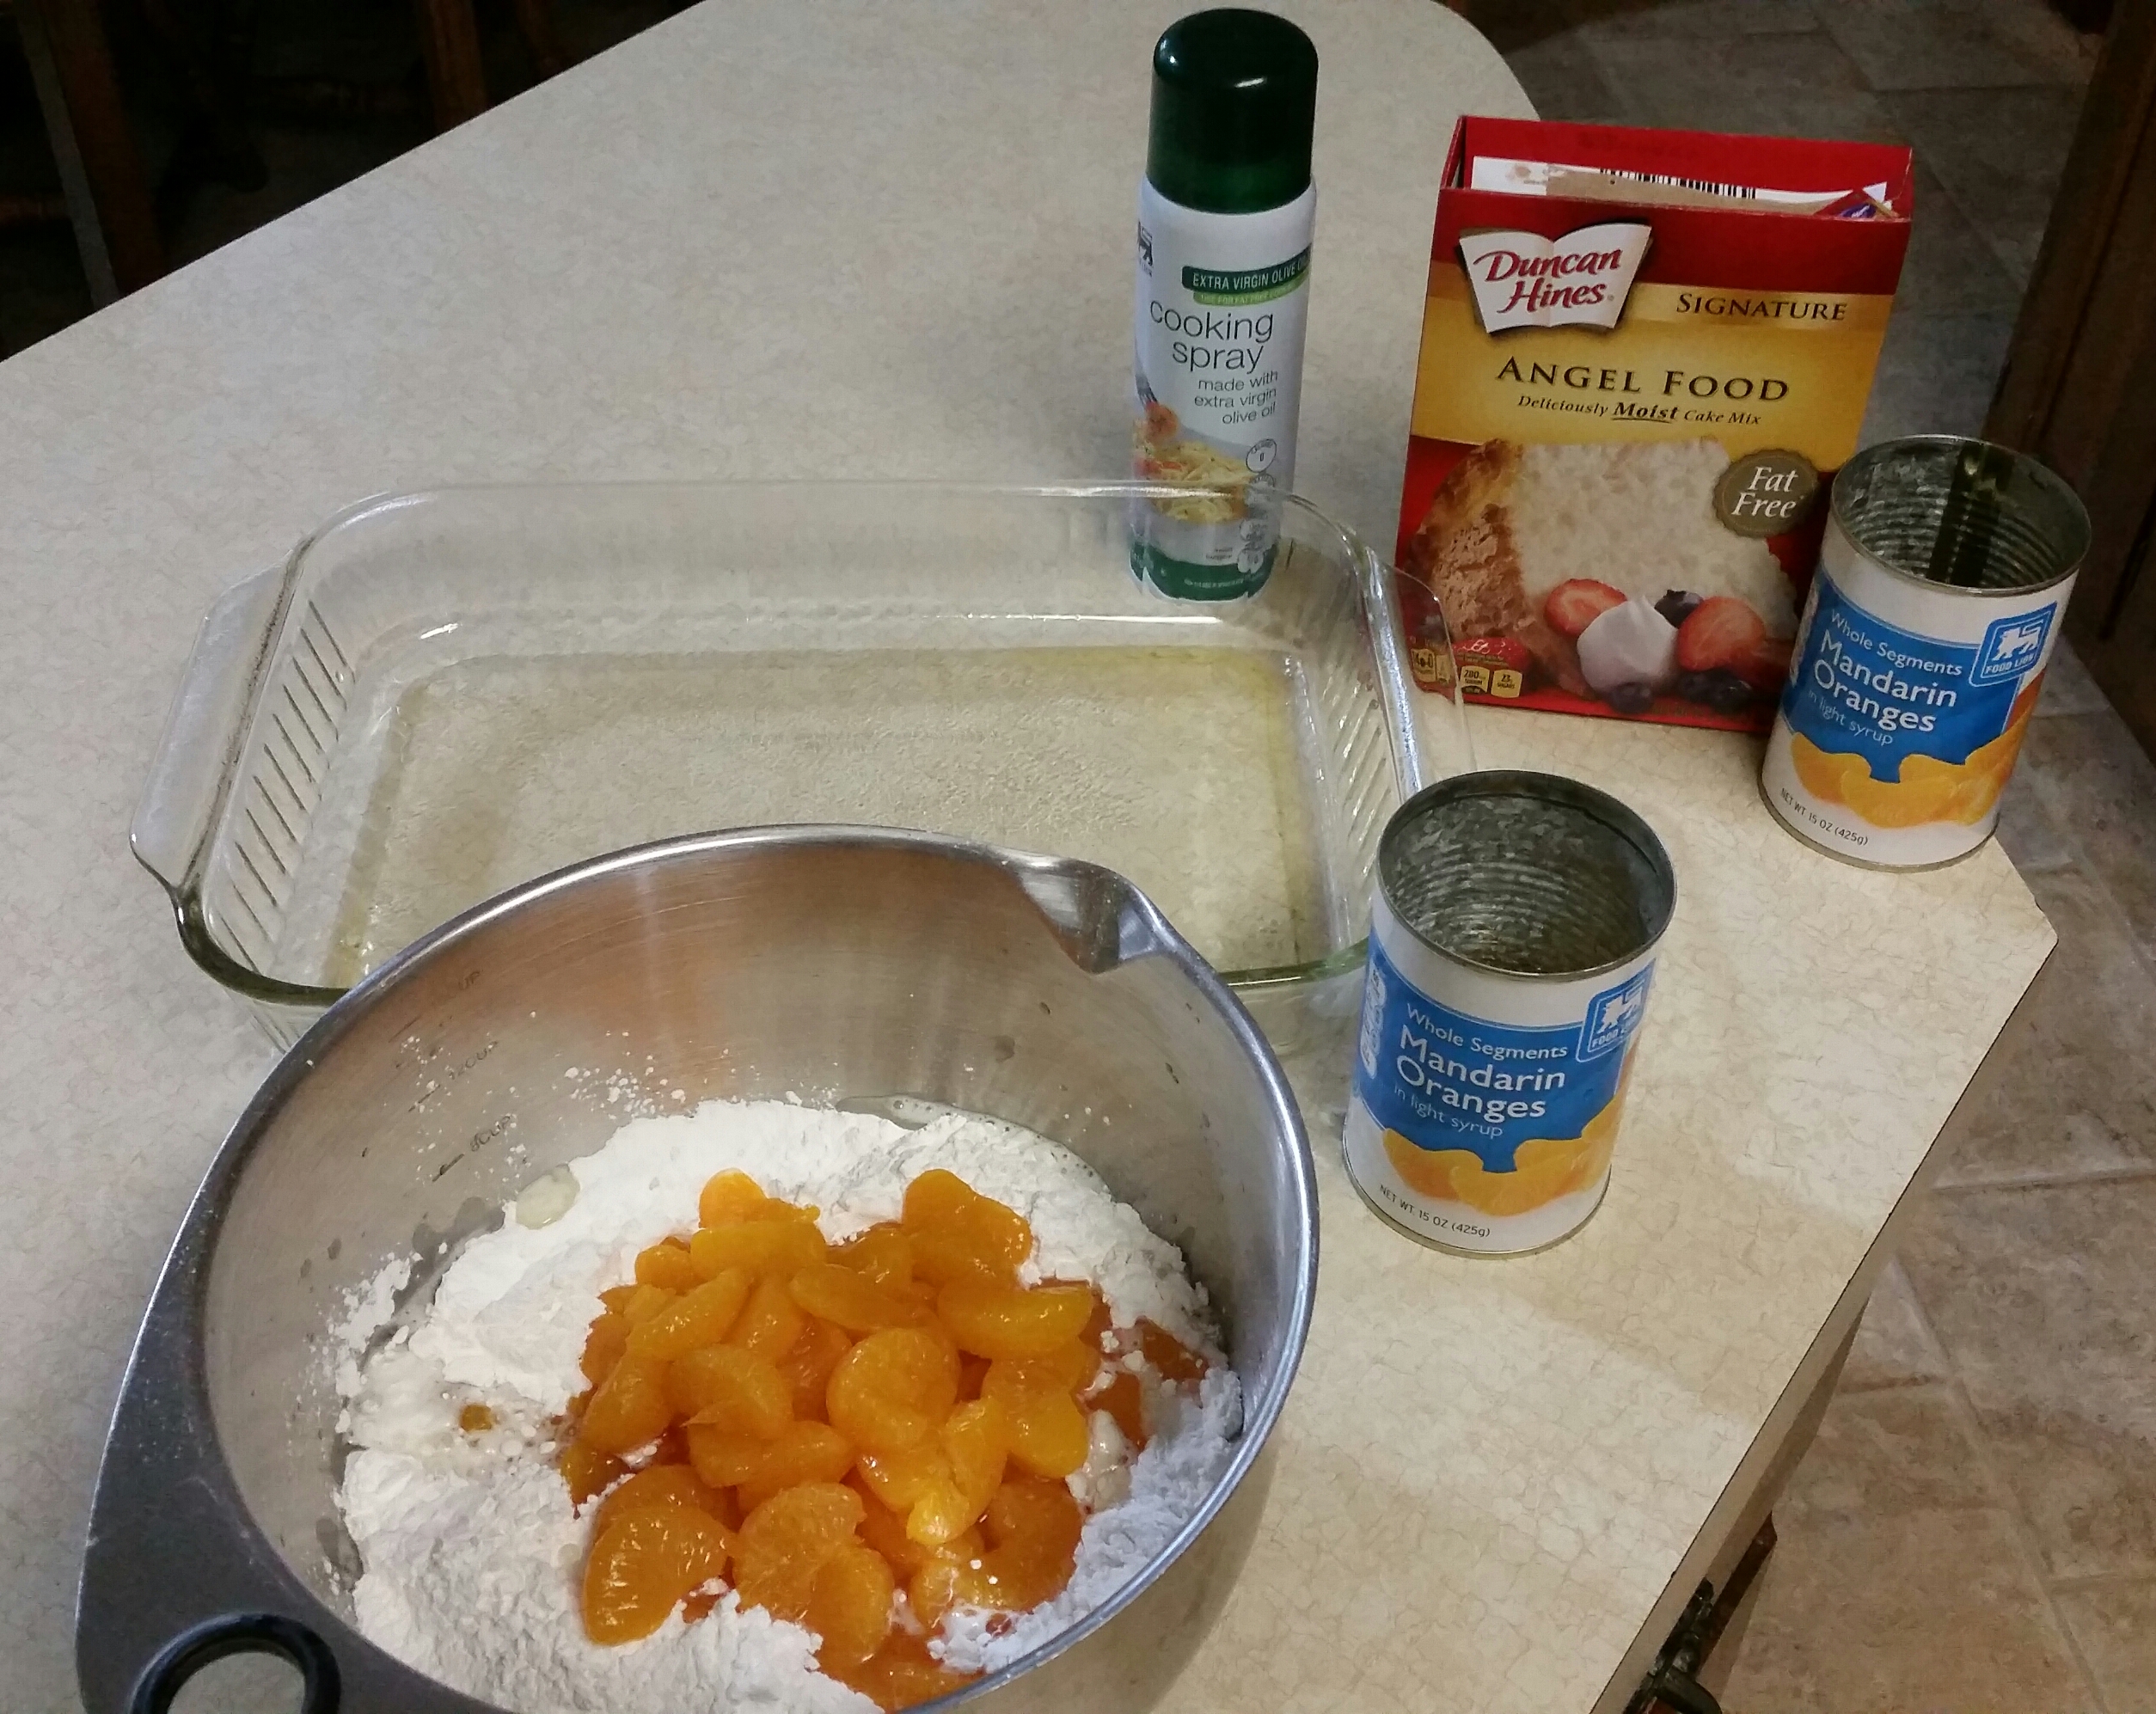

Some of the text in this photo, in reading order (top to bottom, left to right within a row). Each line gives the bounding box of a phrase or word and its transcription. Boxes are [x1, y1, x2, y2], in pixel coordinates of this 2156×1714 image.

[1193, 272, 1229, 290] EXTRA
[1234, 272, 1269, 290] VIRGIN
[1272, 261, 1295, 283] OLIVE
[1473, 246, 1621, 282] Duncan
[1497, 281, 1606, 314] Hines
[1675, 293, 1847, 321] SIGNATURE
[1150, 300, 1273, 344] cooking
[1172, 341, 1265, 374] spray
[1194, 388, 1277, 408] extra virgin
[1198, 370, 1278, 392] made with
[1497, 356, 1789, 401] ANGEL FOOD
[1222, 401, 1276, 424] olive oil
[1518, 395, 1761, 425] Deliciously Moist Cake Mix
[1748, 466, 1799, 493] Fat
[1731, 492, 1797, 518] Free
[1831, 609, 1963, 676] Whole Segments
[1821, 629, 1957, 707] Mandarin
[1985, 661, 2012, 675] FOOD
[1814, 659, 1937, 732] Oranges
[1808, 691, 1894, 746] in light syrup
[1781, 787, 1794, 806] NET
[1808, 812, 1818, 823] 15
[1819, 818, 1833, 831] OZ
[1834, 825, 1869, 847] (425g)
[1406, 1002, 1568, 1062] Whole Segments
[1400, 1025, 1565, 1091] Mandarin
[1397, 1055, 1547, 1124] Oranges
[1394, 1086, 1504, 1140] in light syrup
[1380, 1184, 1398, 1203] NET
[1418, 1209, 1430, 1221] 15
[1433, 1216, 1449, 1229] OZ
[1451, 1222, 1491, 1238] (425g)
